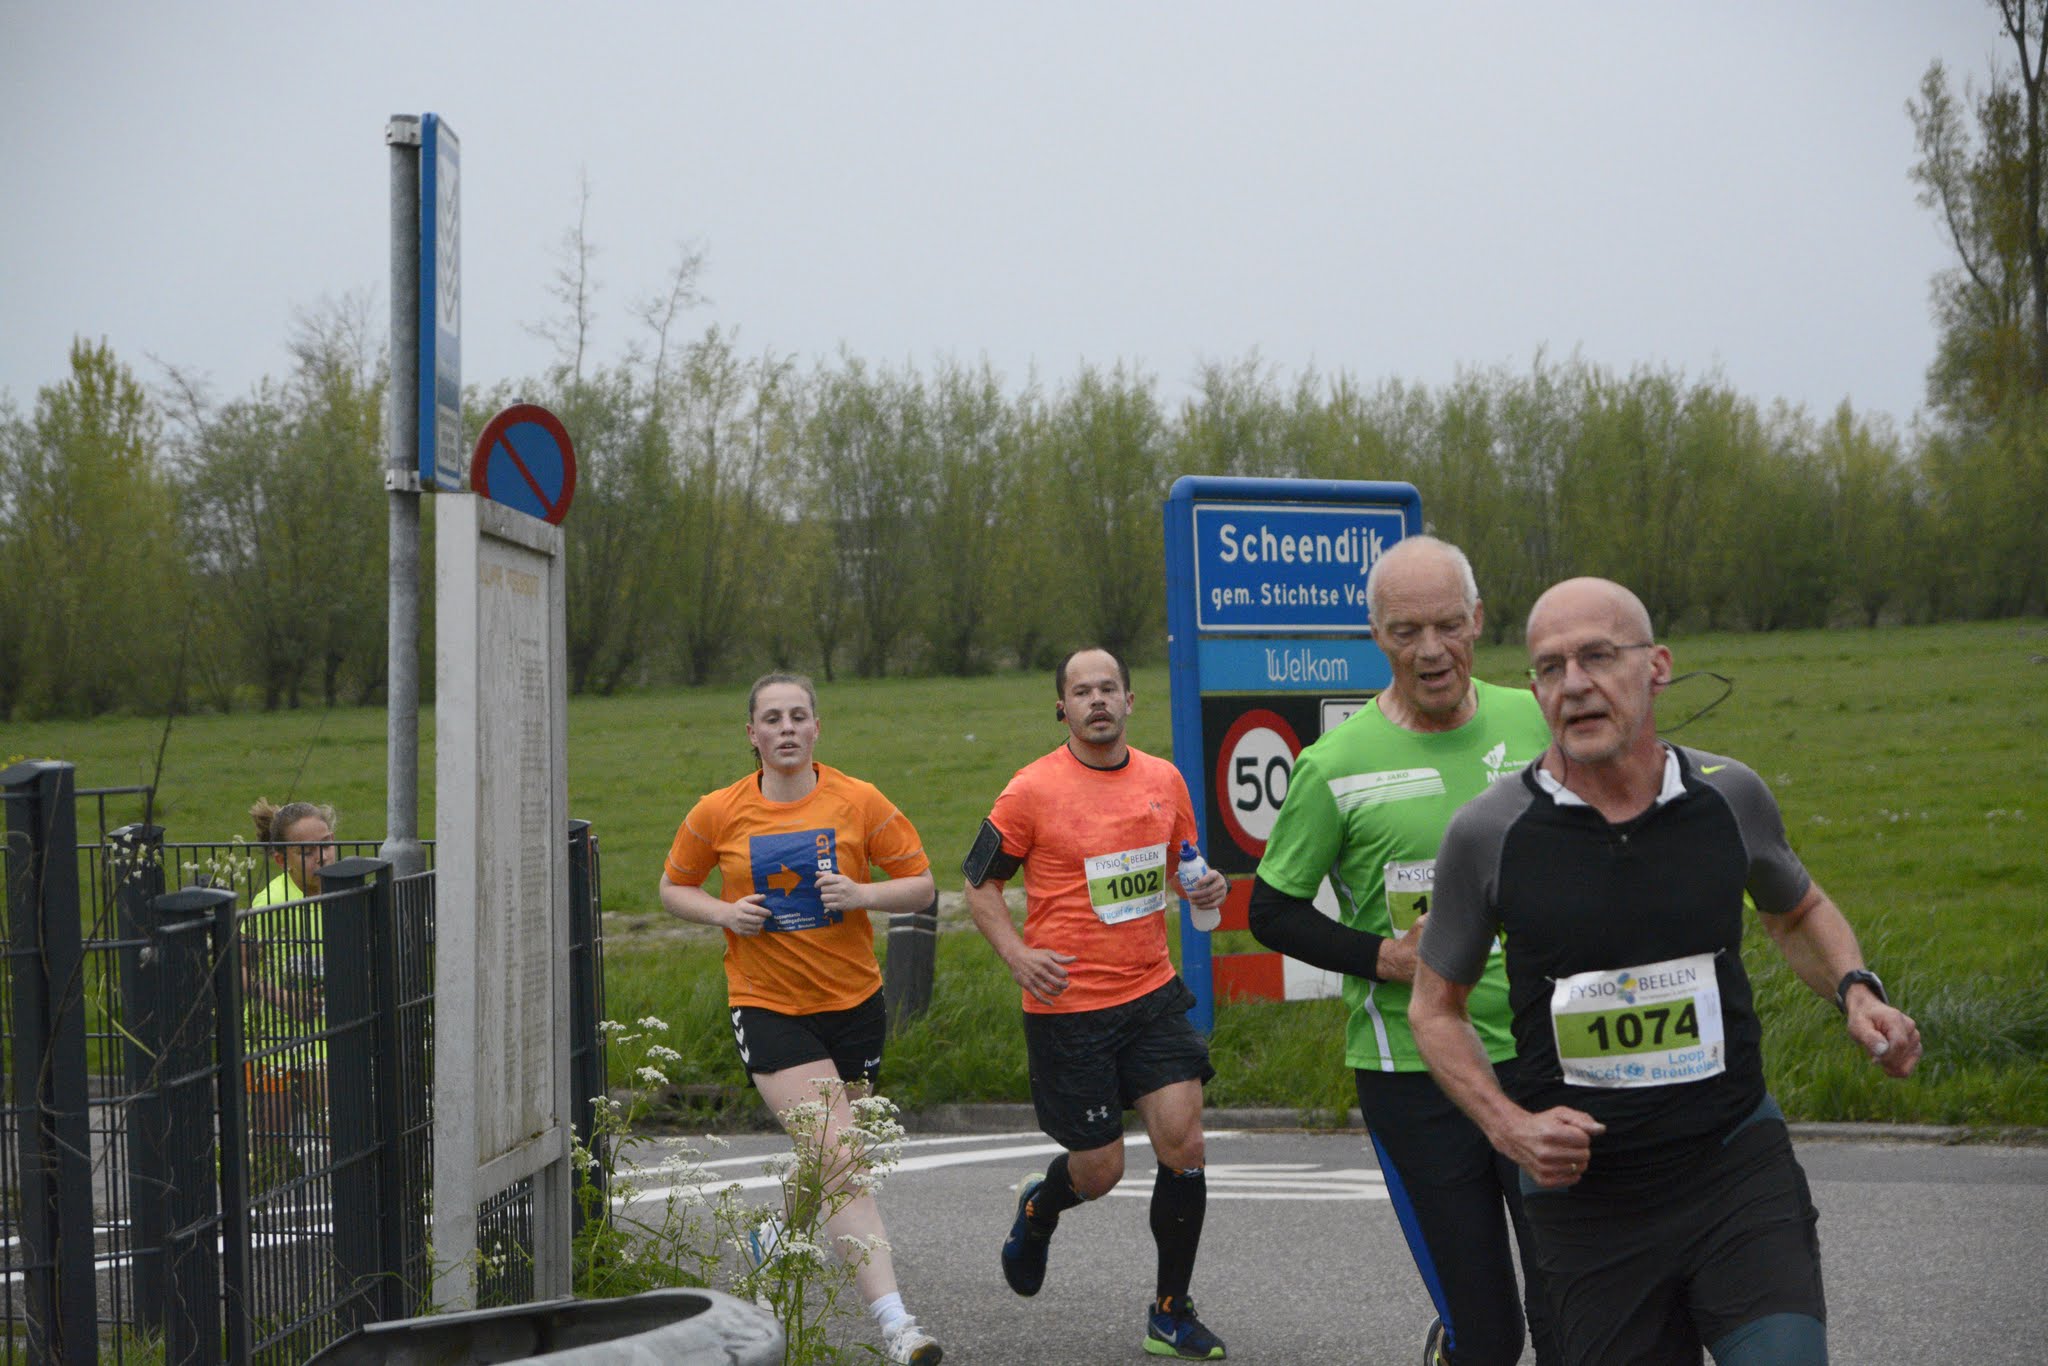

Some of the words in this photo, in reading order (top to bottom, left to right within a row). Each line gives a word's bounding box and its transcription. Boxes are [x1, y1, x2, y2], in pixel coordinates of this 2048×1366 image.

[1219, 523, 1384, 575] Scheendijk
[1211, 586, 1255, 611] gem.
[1261, 582, 1339, 605] Stichtse
[1344, 583, 1368, 605] Ve
[1265, 648, 1348, 681] Welkom
[1235, 755, 1291, 812] 50
[815, 833, 833, 875] GT.B
[1096, 858, 1121, 871] FYSIO
[1130, 851, 1159, 864] BEELEN
[1107, 870, 1158, 899] 1002
[1397, 867, 1436, 881] FYSIO
[1570, 982, 1617, 1000] FYSIO
[1638, 967, 1697, 991] BEELEN
[1587, 1003, 1699, 1051] 1074
[1651, 1058, 1719, 1080] Breukelen
[1668, 1050, 1705, 1066] Loop
